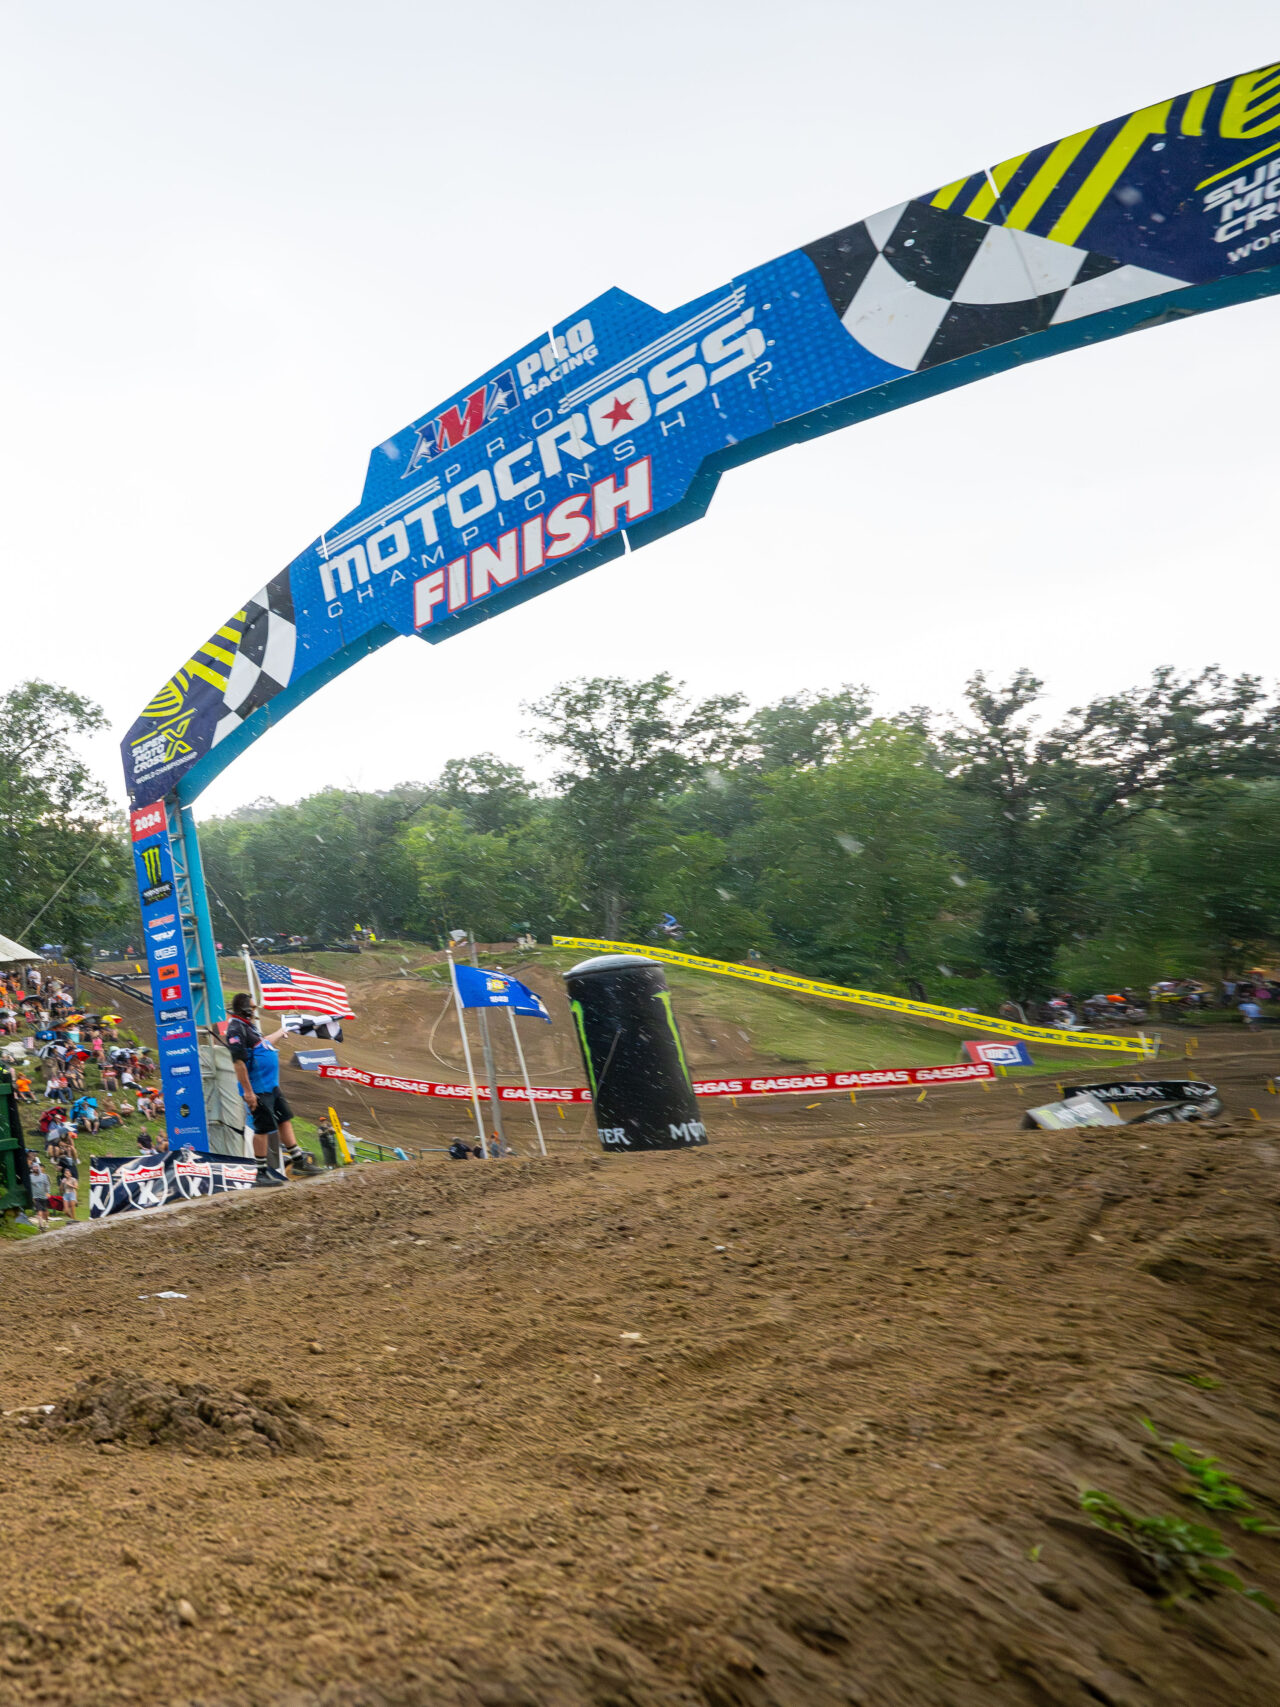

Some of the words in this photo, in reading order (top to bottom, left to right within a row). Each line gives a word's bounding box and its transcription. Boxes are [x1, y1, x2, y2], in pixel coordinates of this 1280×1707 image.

[516, 319, 595, 387] PRO
[523, 344, 599, 401] RACING
[318, 306, 768, 603] MOTOCROSS
[400, 368, 521, 480] AMA
[444, 408, 554, 485] PRO
[327, 361, 774, 619] CHAMPIONSHIP
[413, 455, 653, 631] FINISH
[134, 811, 161, 831] 2024
[373, 1077, 430, 1094] GASGAS
[502, 1088, 574, 1101] GASGAS
[692, 1080, 743, 1094] SGAS
[750, 1075, 828, 1091] GASGAS
[835, 1070, 910, 1086] GASGAS
[915, 1064, 991, 1081] GASGAS
[137, 1180, 161, 1205] X
